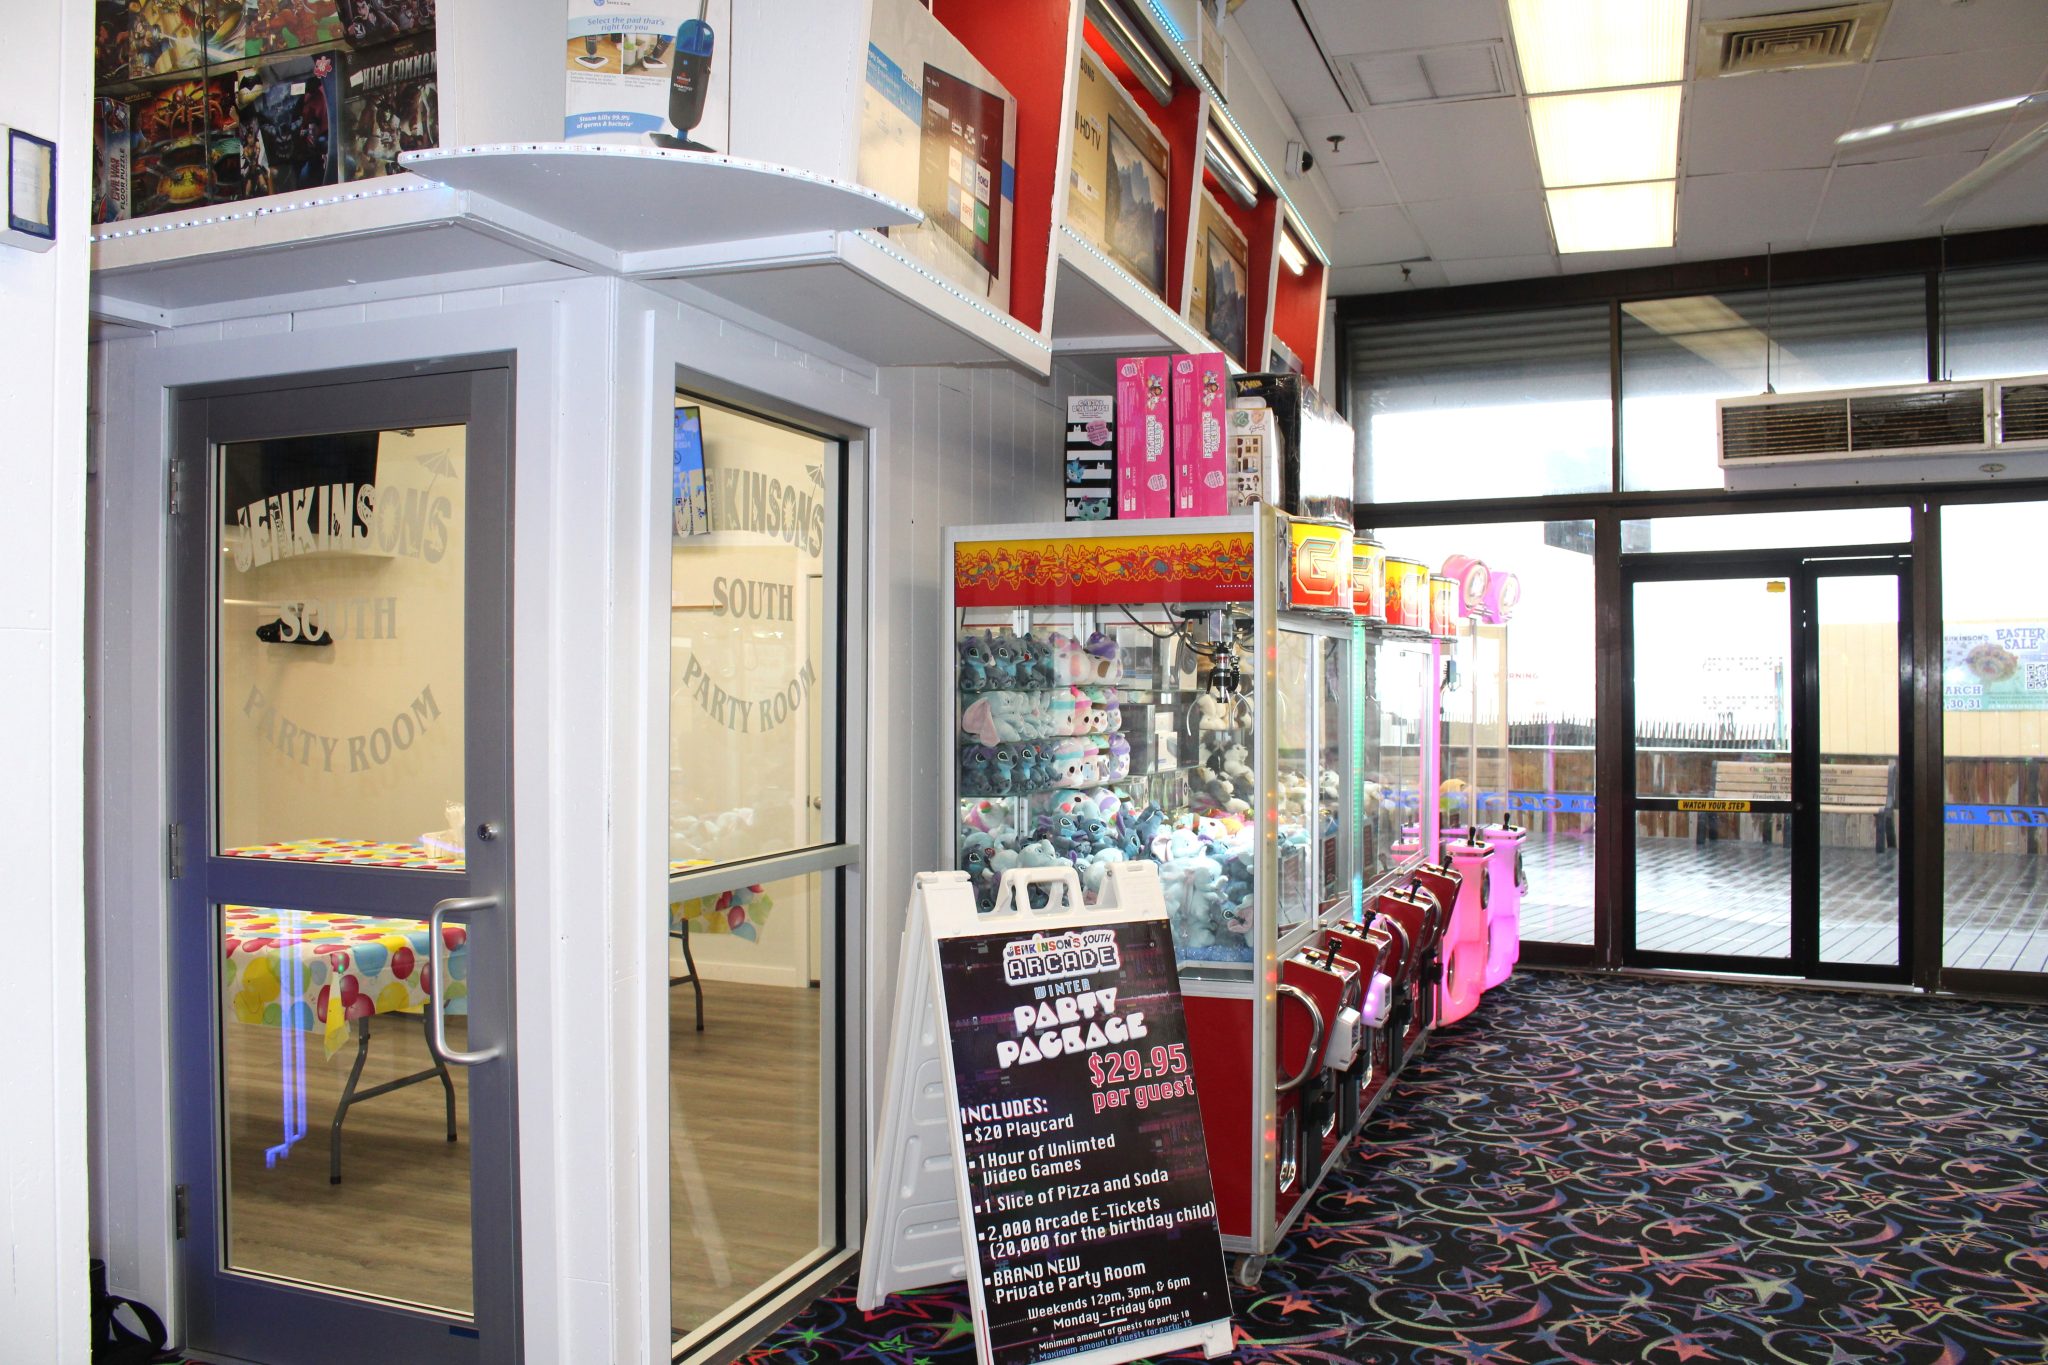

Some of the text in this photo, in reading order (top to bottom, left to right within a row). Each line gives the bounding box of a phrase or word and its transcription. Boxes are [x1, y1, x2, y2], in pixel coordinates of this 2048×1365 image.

[587, 16, 665, 26] Select the pad that's
[601, 24, 620, 32] right
[363, 65, 389, 91] HIGH
[1079, 116, 1091, 139] HD
[1091, 126, 1101, 151] TV
[712, 576, 794, 622] SOUTH
[280, 597, 398, 642] SOUTH
[1996, 628, 2046, 640] EASTER
[2004, 639, 2039, 650] SALE
[682, 653, 817, 734] PARTY ROOM
[243, 684, 442, 773] PARTY ROOM
[1683, 801, 1745, 810] WATCH YOUR STEP
[1006, 933, 1111, 957] JENKINSON'S SOUTH
[1007, 946, 1117, 980] ARCADE
[1034, 978, 1091, 999] WINTER
[1013, 987, 1118, 1033] PARTY
[996, 1011, 1148, 1069] PACKAGE
[1088, 1043, 1188, 1088] $29.95
[961, 1097, 1048, 1125] INCLUDES:
[1092, 1074, 1195, 1114] per guest
[974, 1113, 1074, 1144] $20 Playcard
[987, 1151, 1025, 1168] Hour
[1029, 1145, 1044, 1161] of
[1048, 1134, 1116, 1159] Unlimted
[983, 1158, 1082, 1186] Video Games
[984, 1168, 1169, 1214] 1 Slice of Pizza and Soda
[987, 1196, 1160, 1242] 2,000 Arcade E-Tickets
[990, 1201, 1215, 1261] (20,000 for the birthday child)
[993, 1255, 1081, 1287] BRAND NEW
[995, 1262, 1147, 1304] Private Party Room
[1027, 1276, 1191, 1320] Weekends 12pm, 3pm, & 6pm
[1053, 1311, 1100, 1330] Monday
[1110, 1300, 1146, 1318] Friday
[1147, 1295, 1172, 1311] 6pm
[1038, 1309, 1190, 1350] Minimum amount of guests for party: 10
[1039, 1318, 1193, 1361] Maximum amount of guests for party: 15
